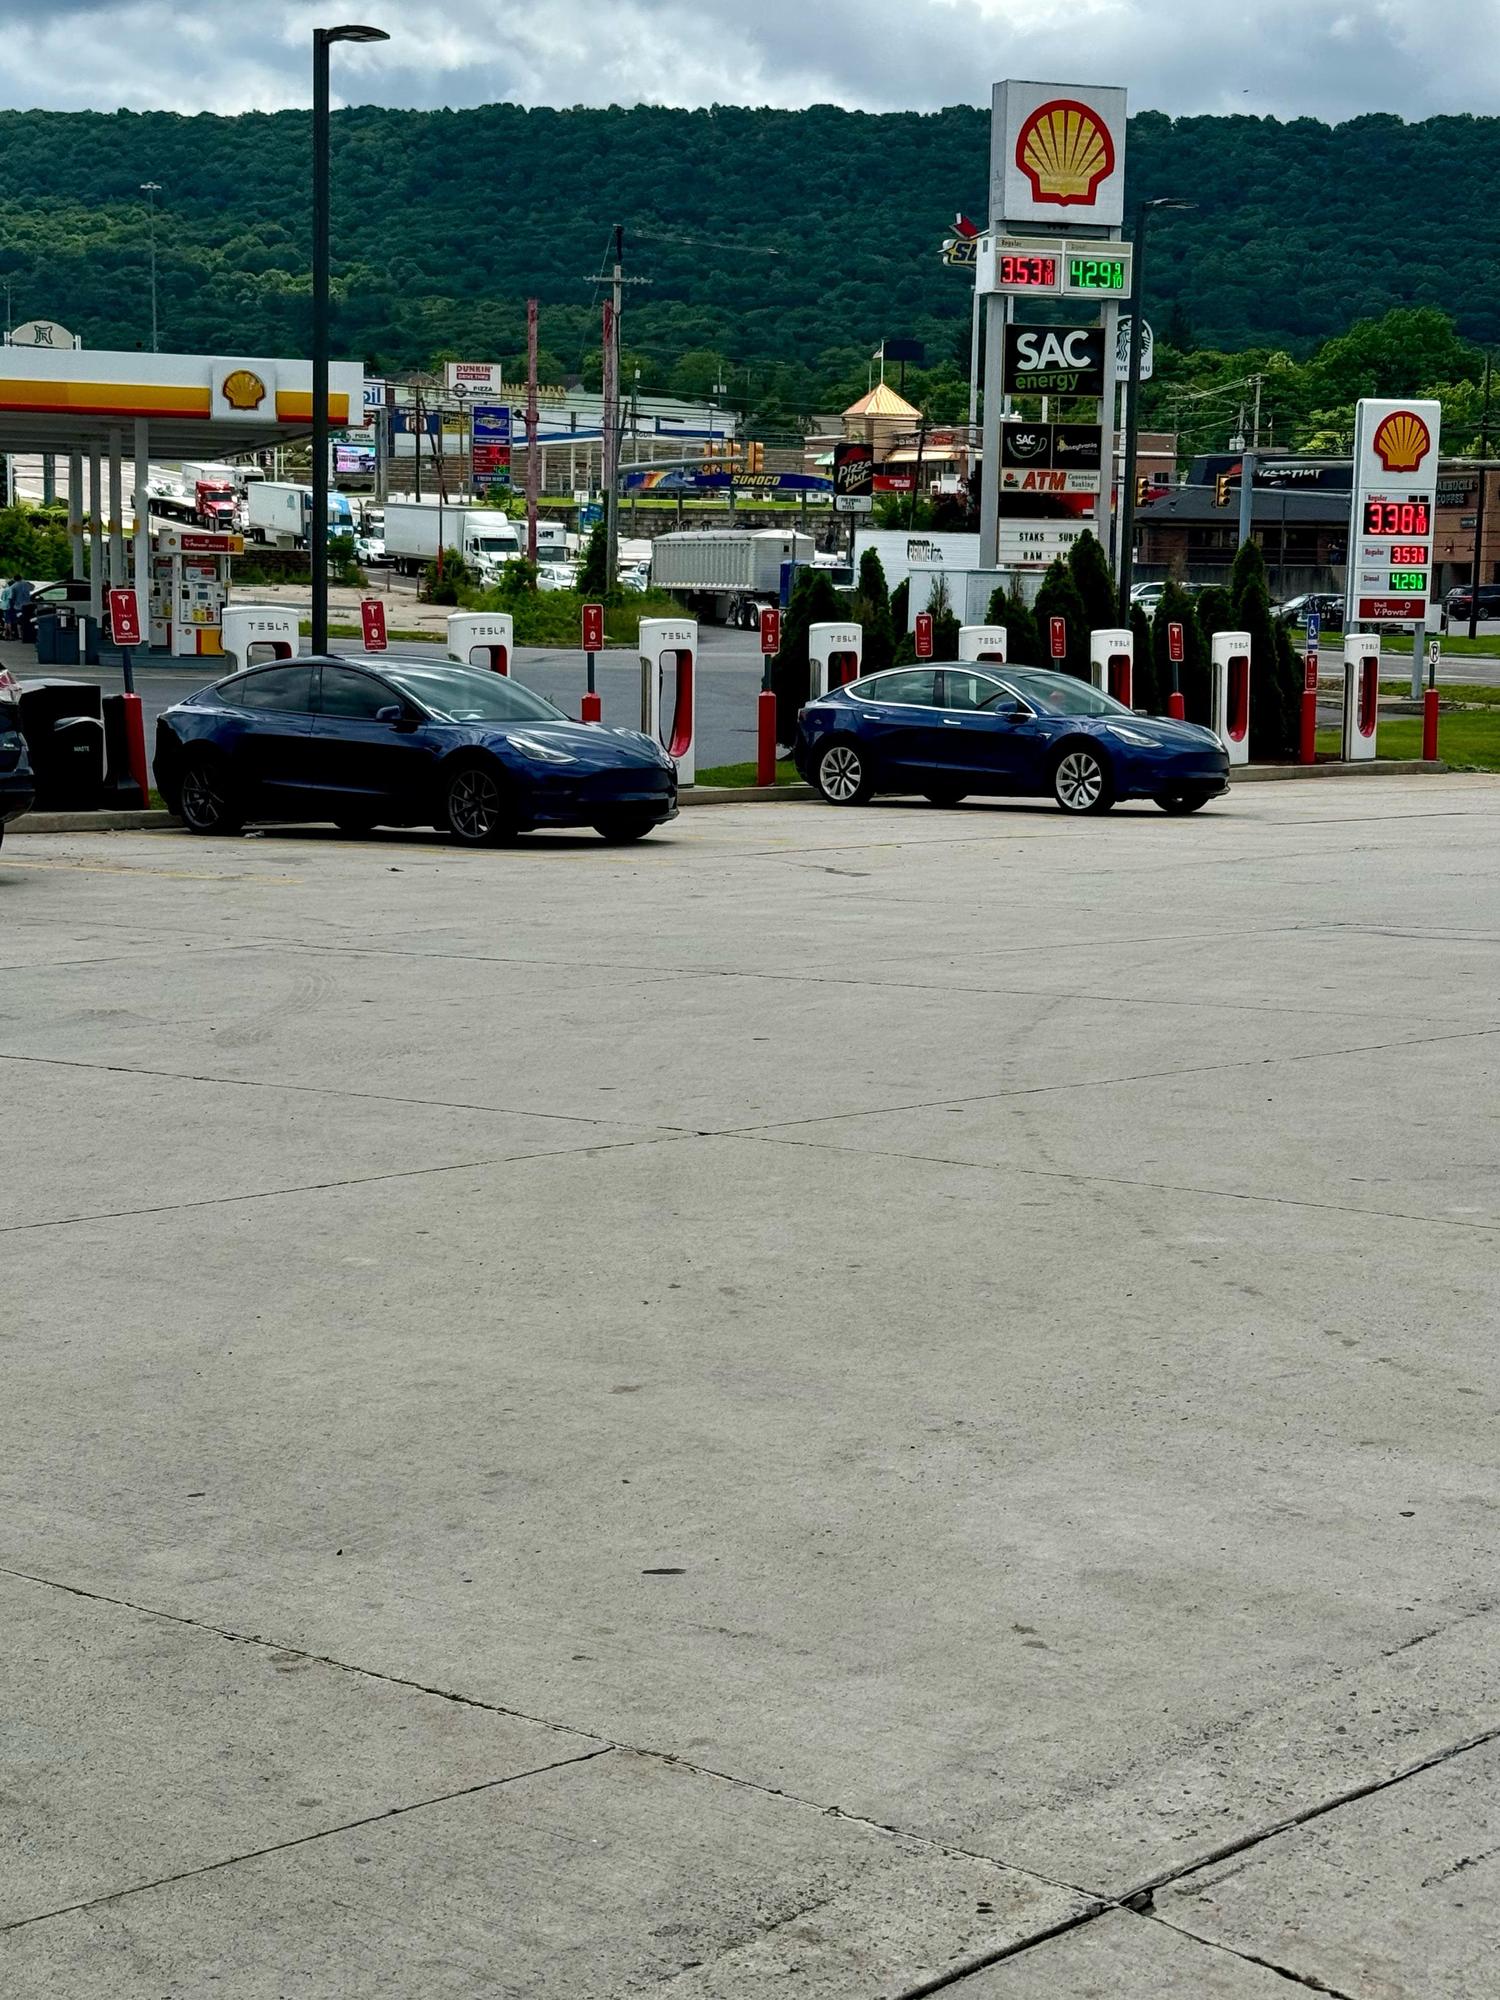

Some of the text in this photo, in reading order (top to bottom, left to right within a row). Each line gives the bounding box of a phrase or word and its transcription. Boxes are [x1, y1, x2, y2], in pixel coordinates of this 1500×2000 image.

[1016, 330, 1092, 371] SAC
[1015, 373, 1080, 392] energy
[1015, 434, 1036, 445] SAC
[837, 460, 873, 484] Pizza
[731, 474, 782, 487] SUNOCO
[844, 469, 870, 488] Hut
[1021, 471, 1068, 491] ATM
[1373, 607, 1409, 616] V-Power
[248, 622, 289, 631] TESLA
[470, 627, 506, 635] TESLA
[660, 632, 692, 640] TESLA
[830, 635, 857, 643] TESLA
[978, 637, 1003, 645] TESLA
